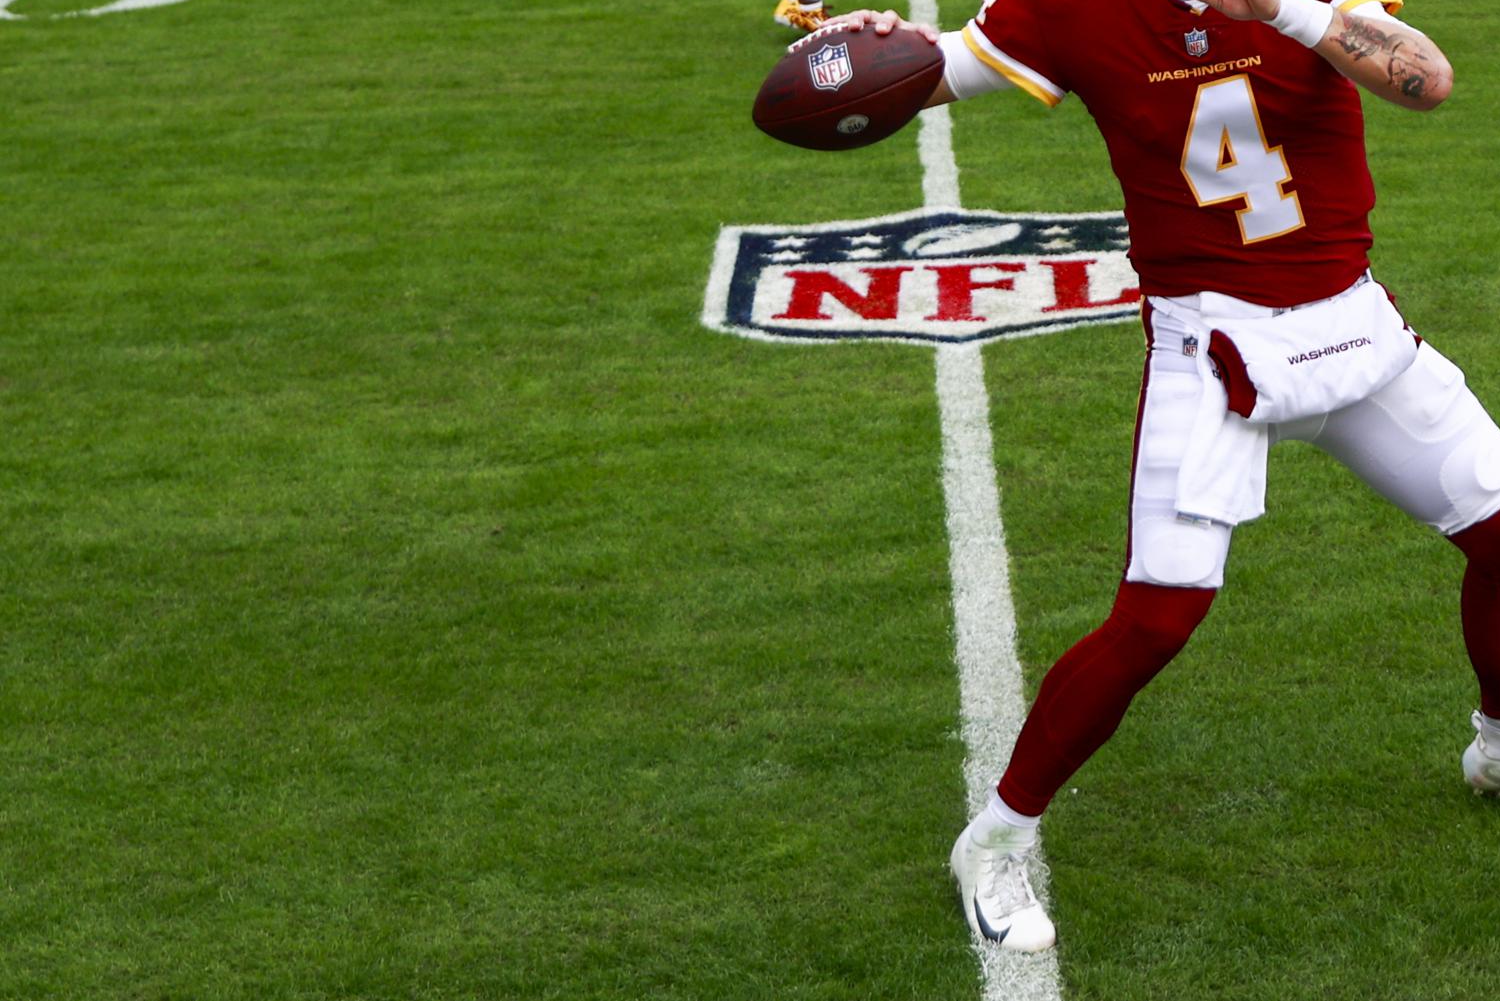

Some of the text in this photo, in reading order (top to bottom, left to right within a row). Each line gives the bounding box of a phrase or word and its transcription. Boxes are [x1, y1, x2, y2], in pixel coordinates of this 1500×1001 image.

[816, 61, 848, 85] NFL
[1148, 55, 1262, 83] WASHINGTON
[1180, 73, 1306, 245] 4
[771, 259, 1142, 322] NFL
[1287, 336, 1372, 365] WASHINGTON
